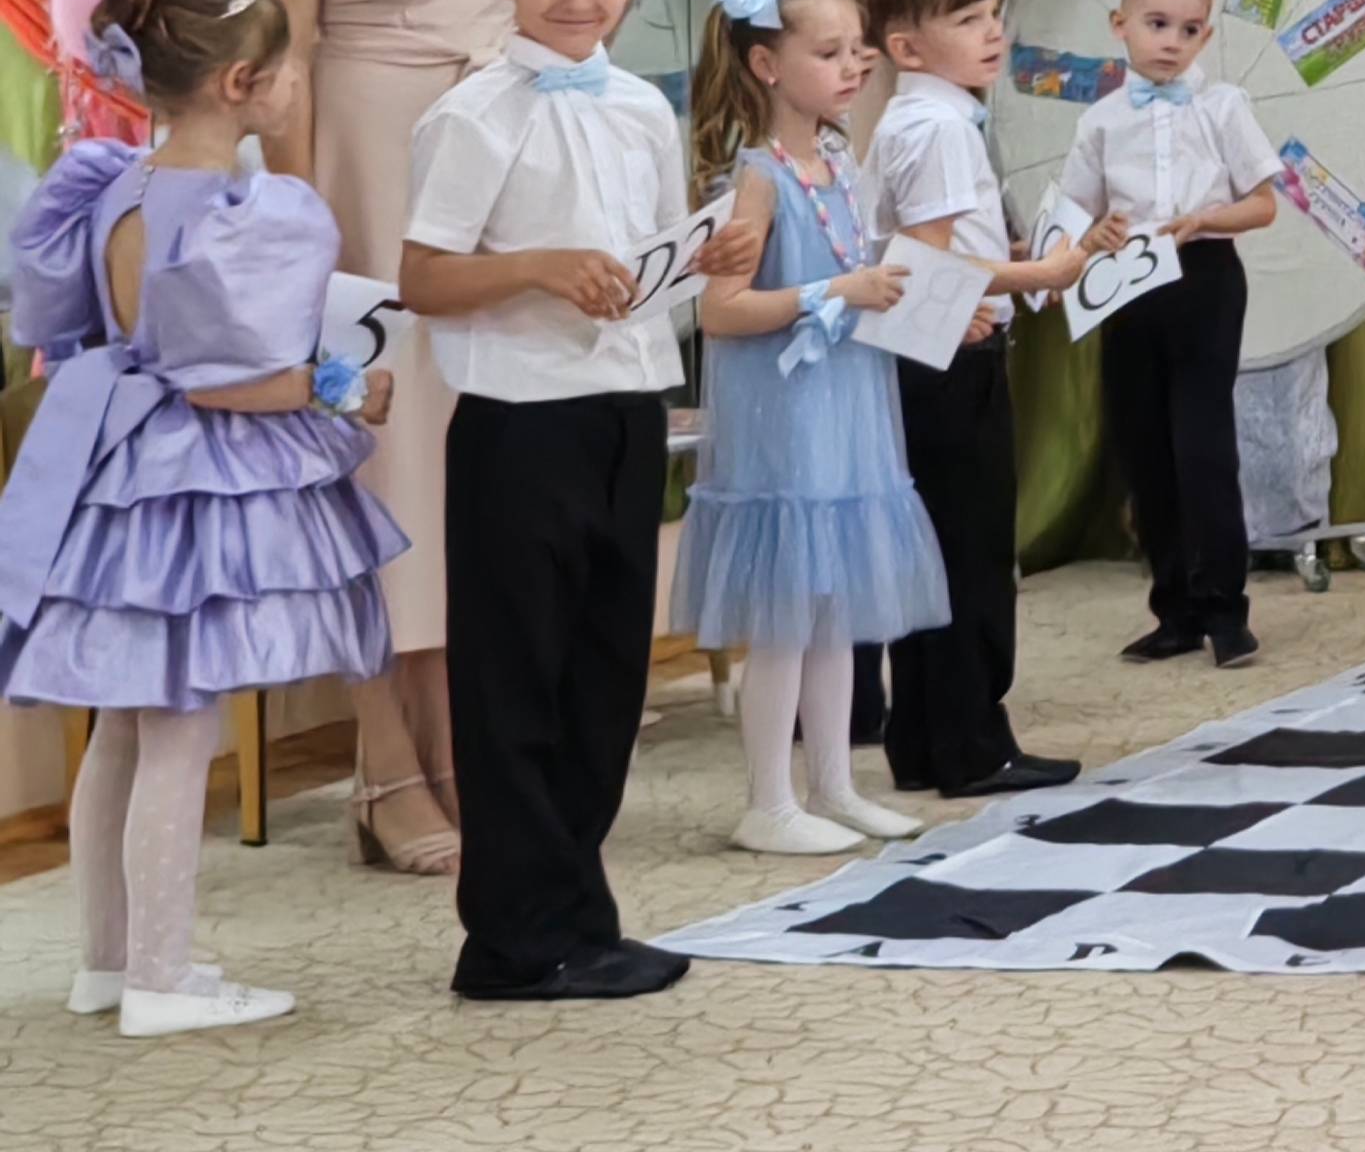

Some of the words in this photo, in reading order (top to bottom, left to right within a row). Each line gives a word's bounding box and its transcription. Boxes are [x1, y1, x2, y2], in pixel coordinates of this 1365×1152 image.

[628, 216, 715, 311] D2
[1078, 234, 1158, 310] C3
[356, 299, 407, 368] 5
